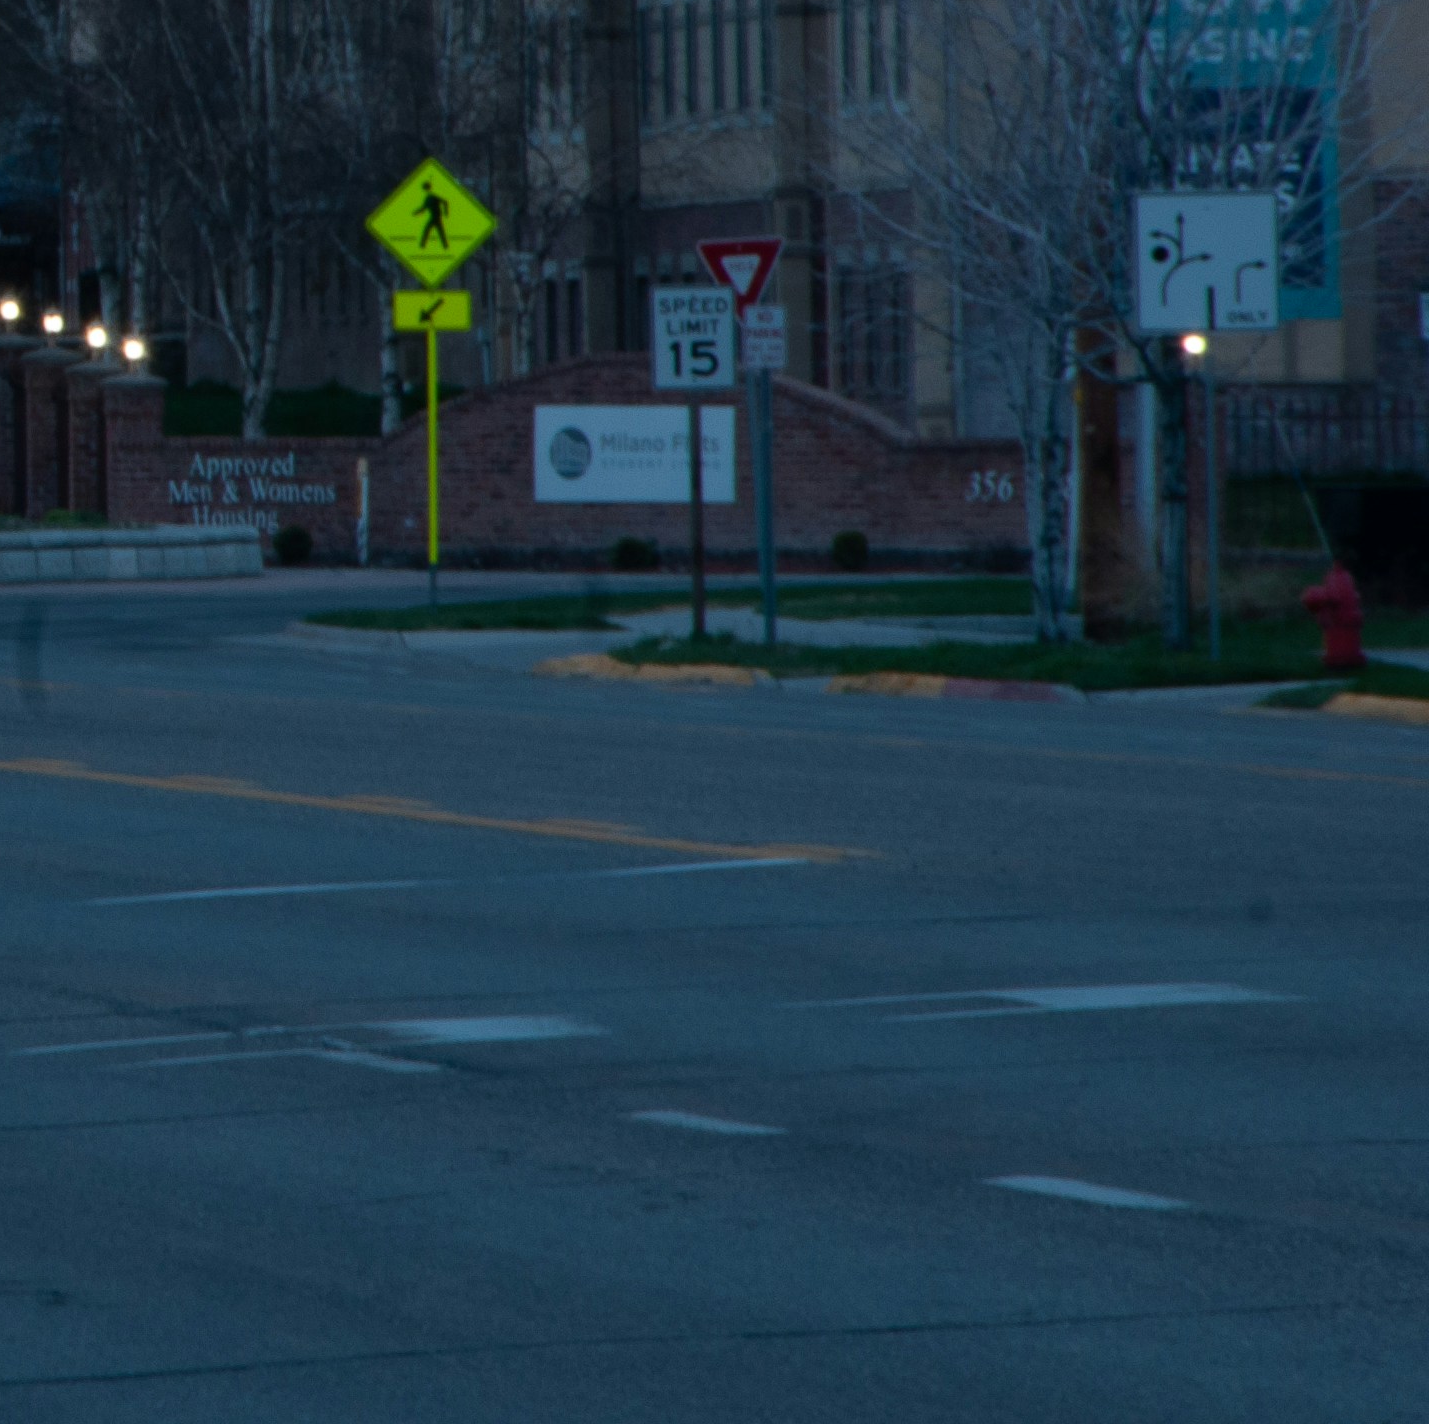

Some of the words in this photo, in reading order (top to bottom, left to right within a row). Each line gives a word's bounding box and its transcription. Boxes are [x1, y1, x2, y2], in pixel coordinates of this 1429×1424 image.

[659, 296, 728, 313] SPEED
[666, 318, 720, 336] LIMIT
[669, 340, 719, 378] 15
[600, 432, 665, 453] Milano
[189, 451, 294, 480] Approved
[168, 479, 213, 504] Men
[222, 479, 239, 504] &
[248, 477, 337, 504] Womens
[964, 469, 1015, 504] 356
[193, 504, 279, 535] Housing
